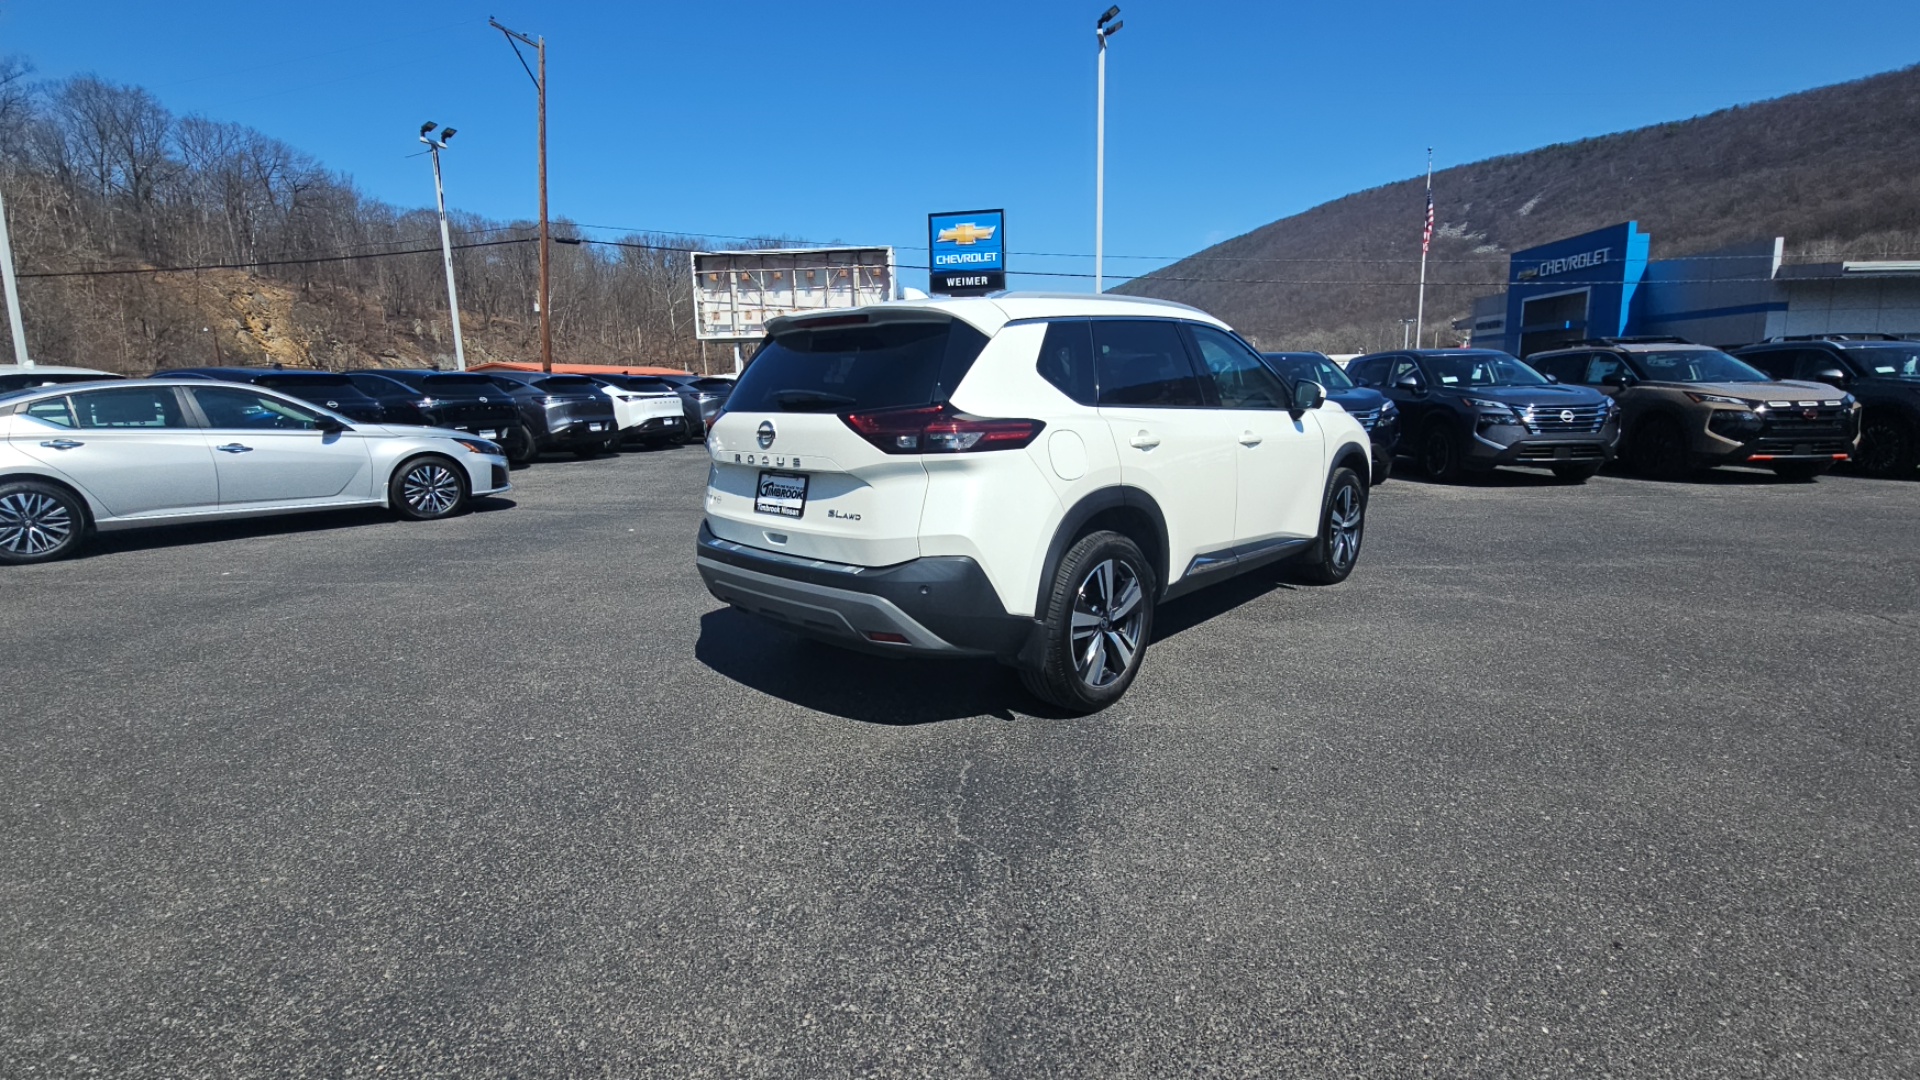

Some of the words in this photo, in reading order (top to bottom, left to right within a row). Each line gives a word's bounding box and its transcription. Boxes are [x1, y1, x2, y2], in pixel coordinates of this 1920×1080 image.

[936, 252, 998, 264] CHEVROLET
[1539, 247, 1612, 276] CHEVROLET
[946, 276, 988, 286] WEIMER
[735, 454, 800, 467] ROGUE
[760, 480, 804, 499] TIMBROOK
